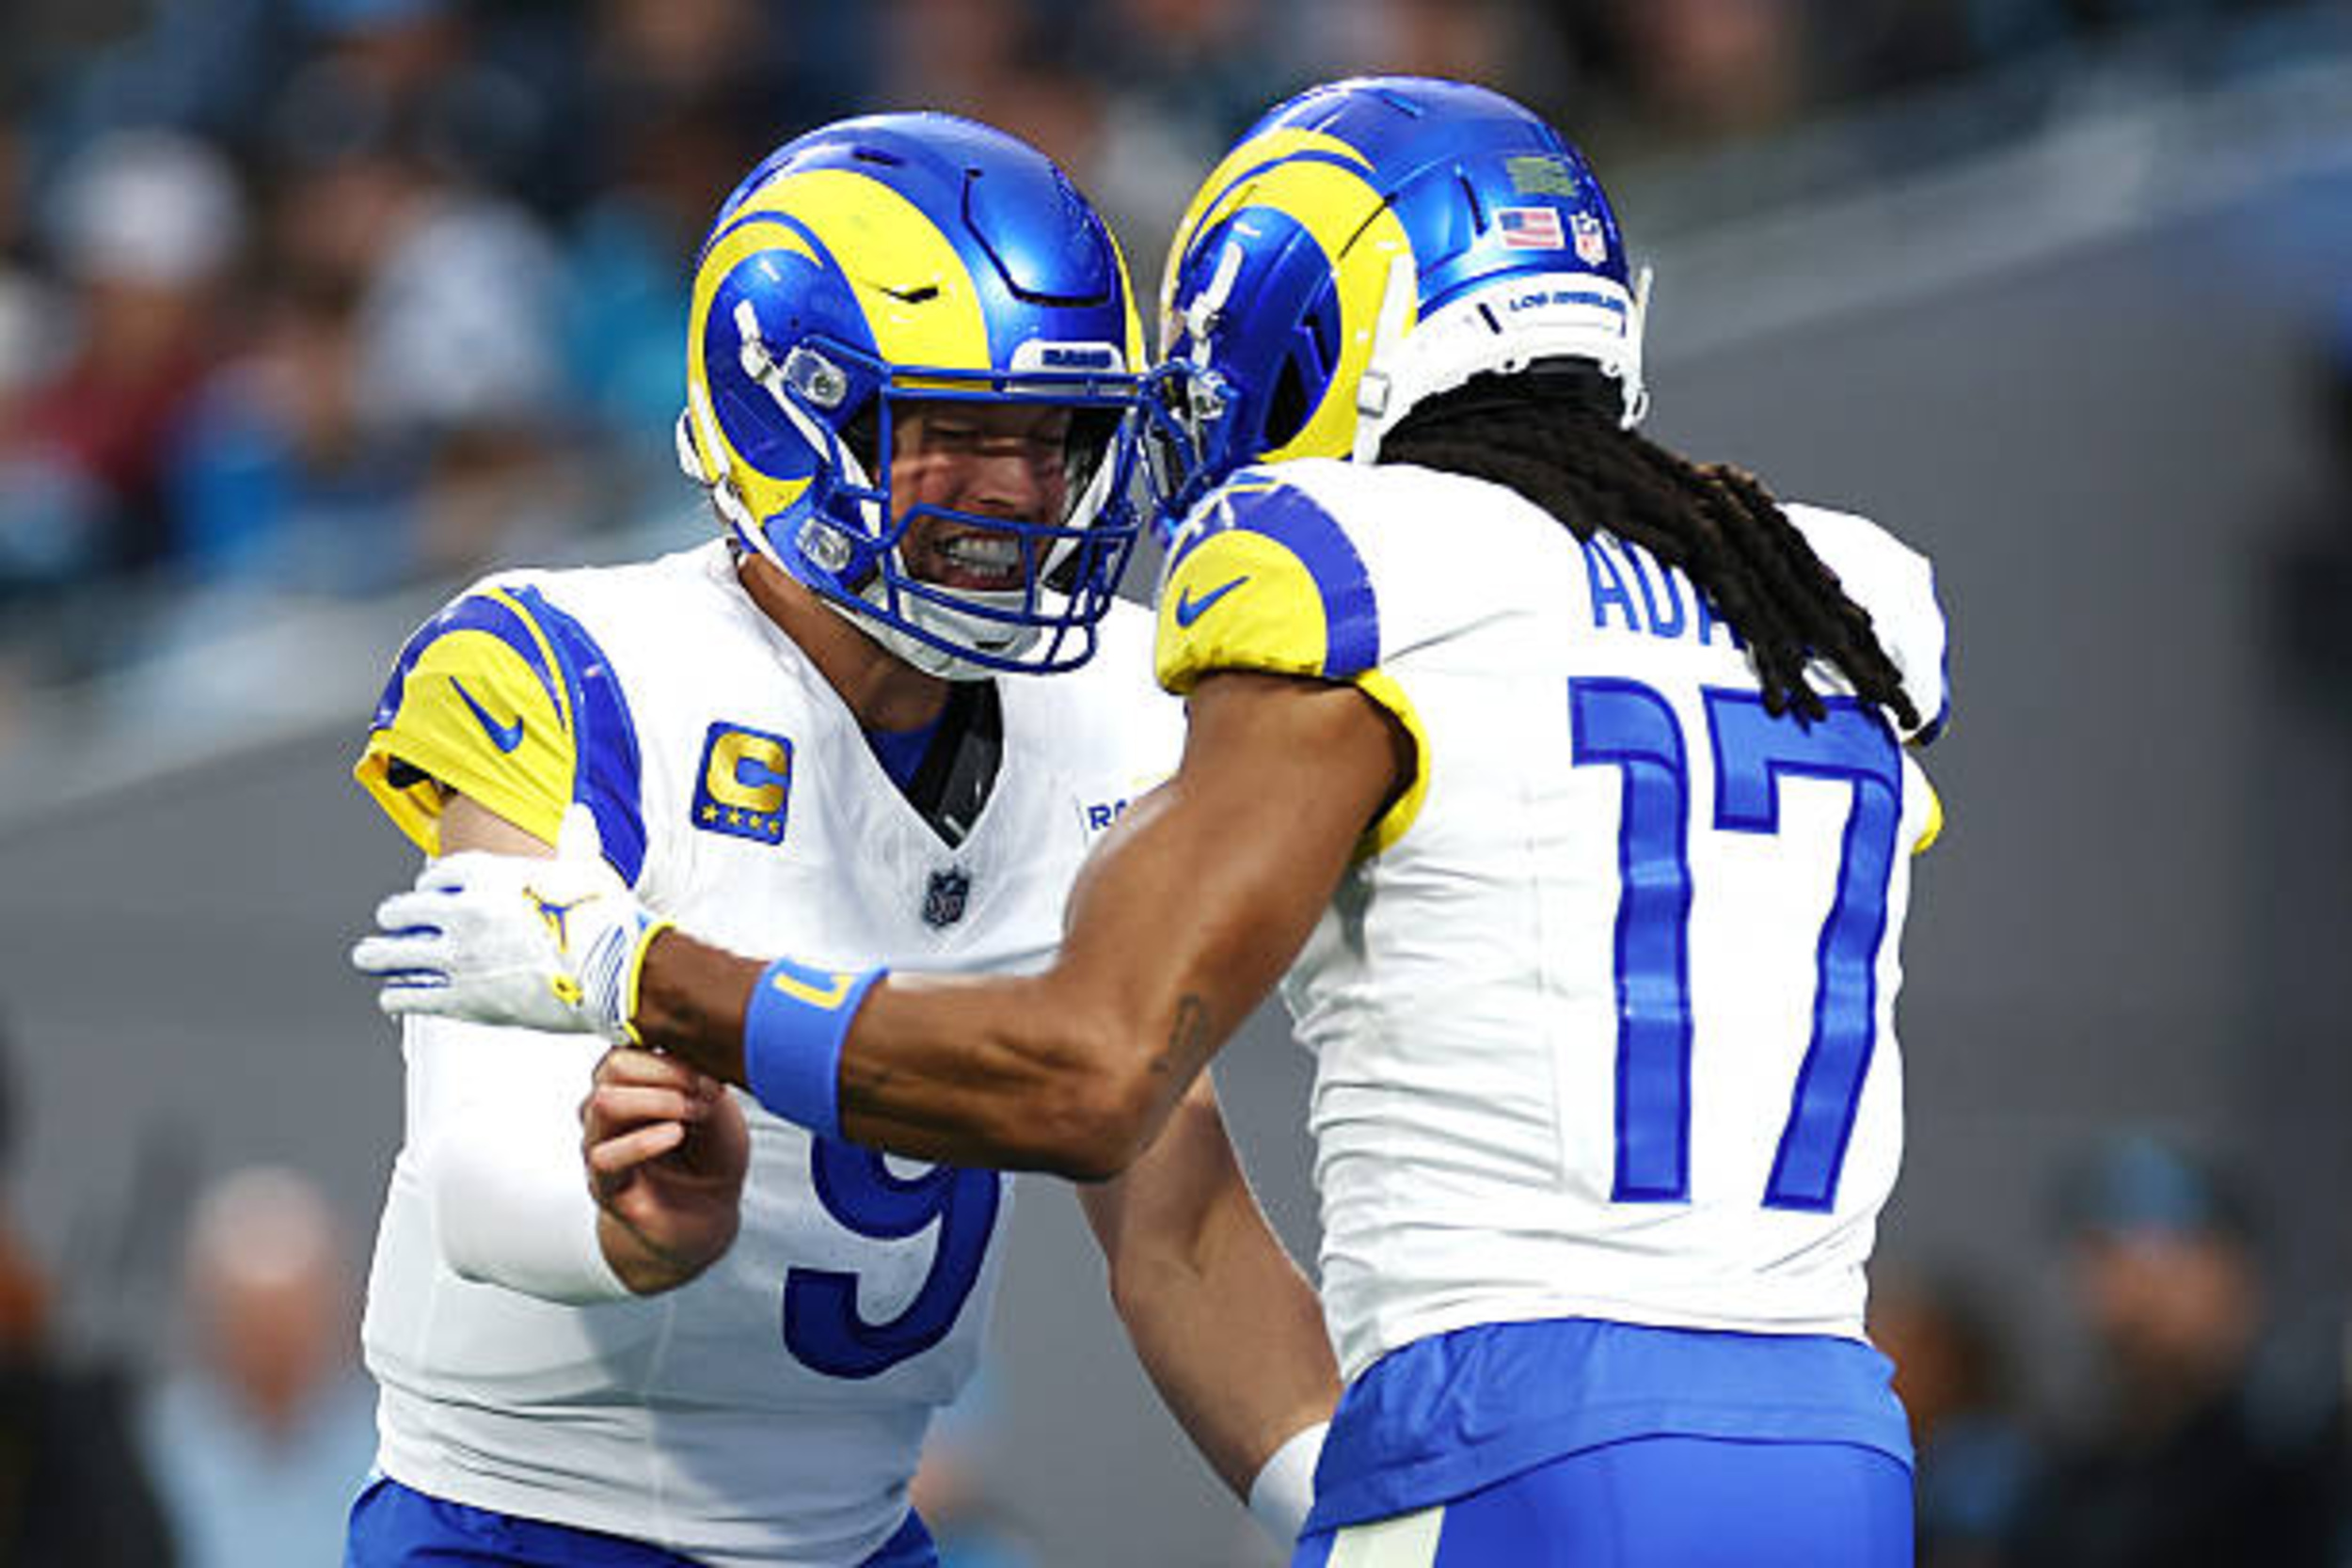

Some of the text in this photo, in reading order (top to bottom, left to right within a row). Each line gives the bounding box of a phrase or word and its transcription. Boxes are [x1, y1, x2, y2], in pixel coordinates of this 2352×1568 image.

[707, 731, 788, 814] C
[1568, 676, 1902, 1213] 17
[783, 1135, 1000, 1380] 9
